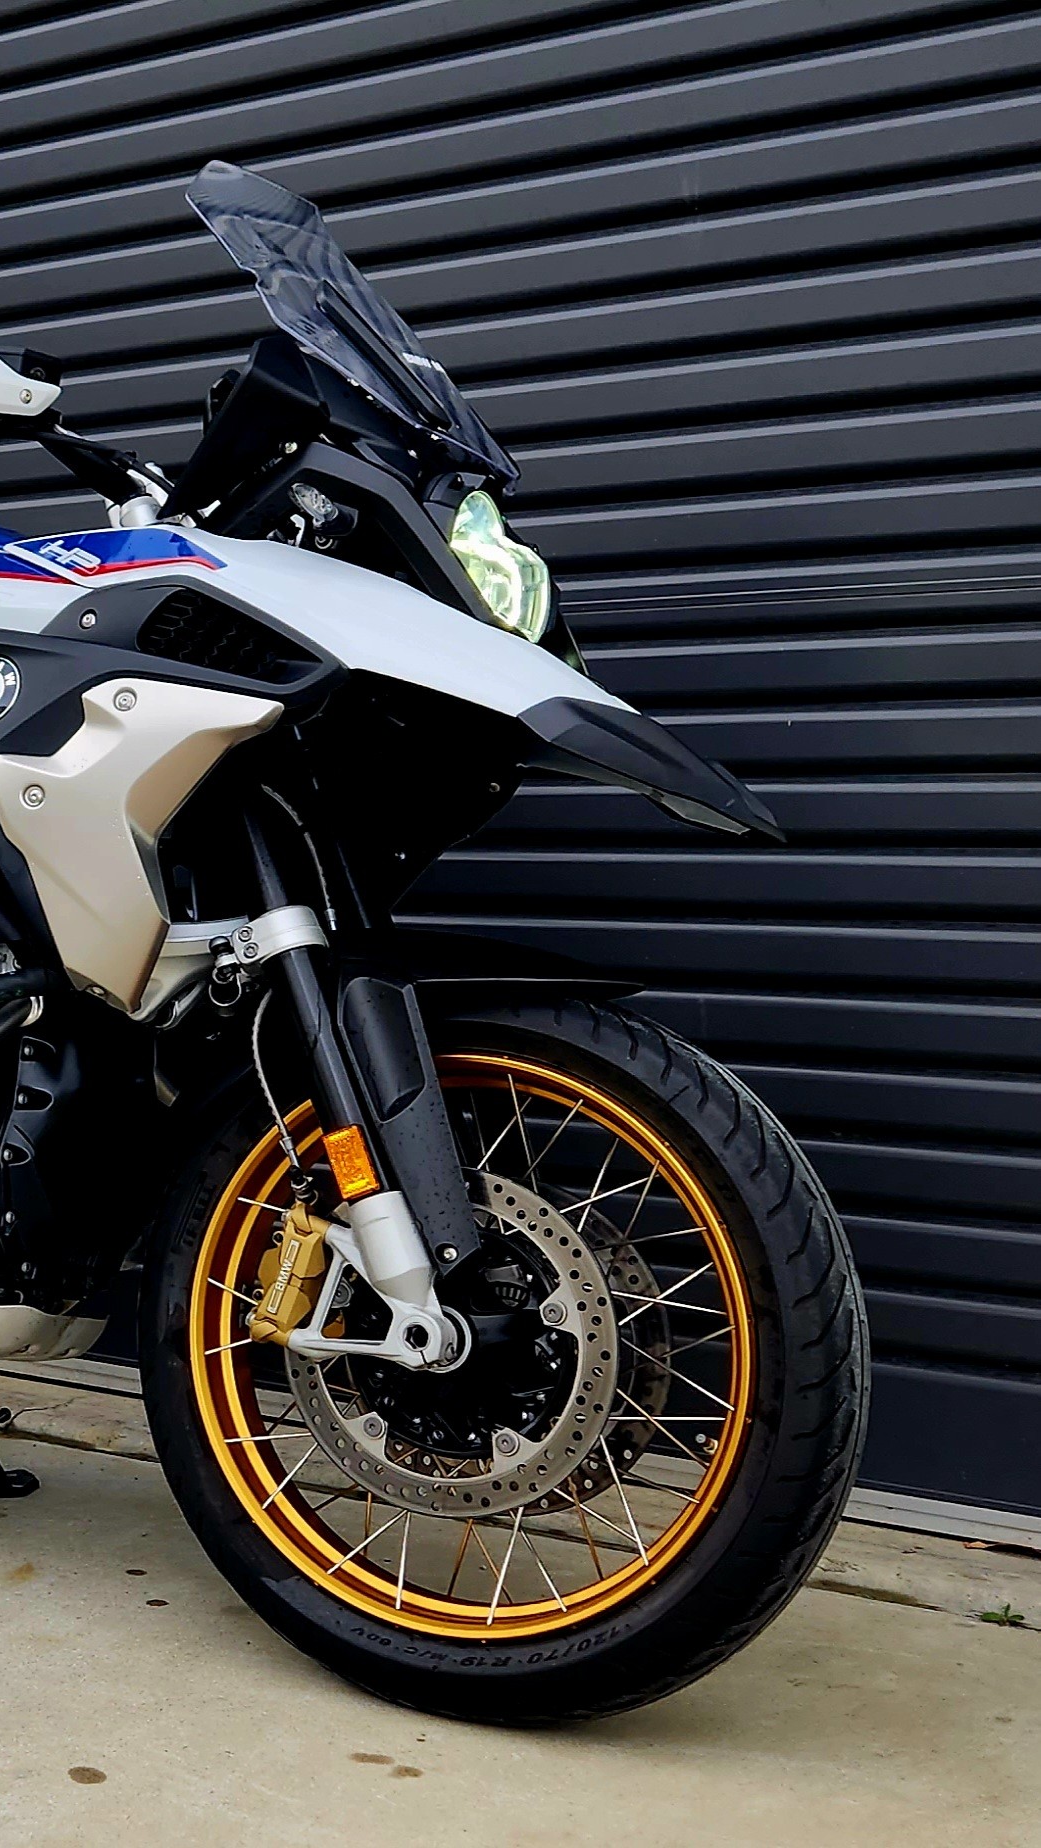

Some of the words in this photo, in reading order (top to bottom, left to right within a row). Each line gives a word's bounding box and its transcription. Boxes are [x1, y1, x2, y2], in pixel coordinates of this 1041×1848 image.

[39, 539, 102, 574] HP
[275, 1258, 293, 1290] BMW
[459, 1656, 512, 1668] R19
[527, 1626, 620, 1665] 120/70
